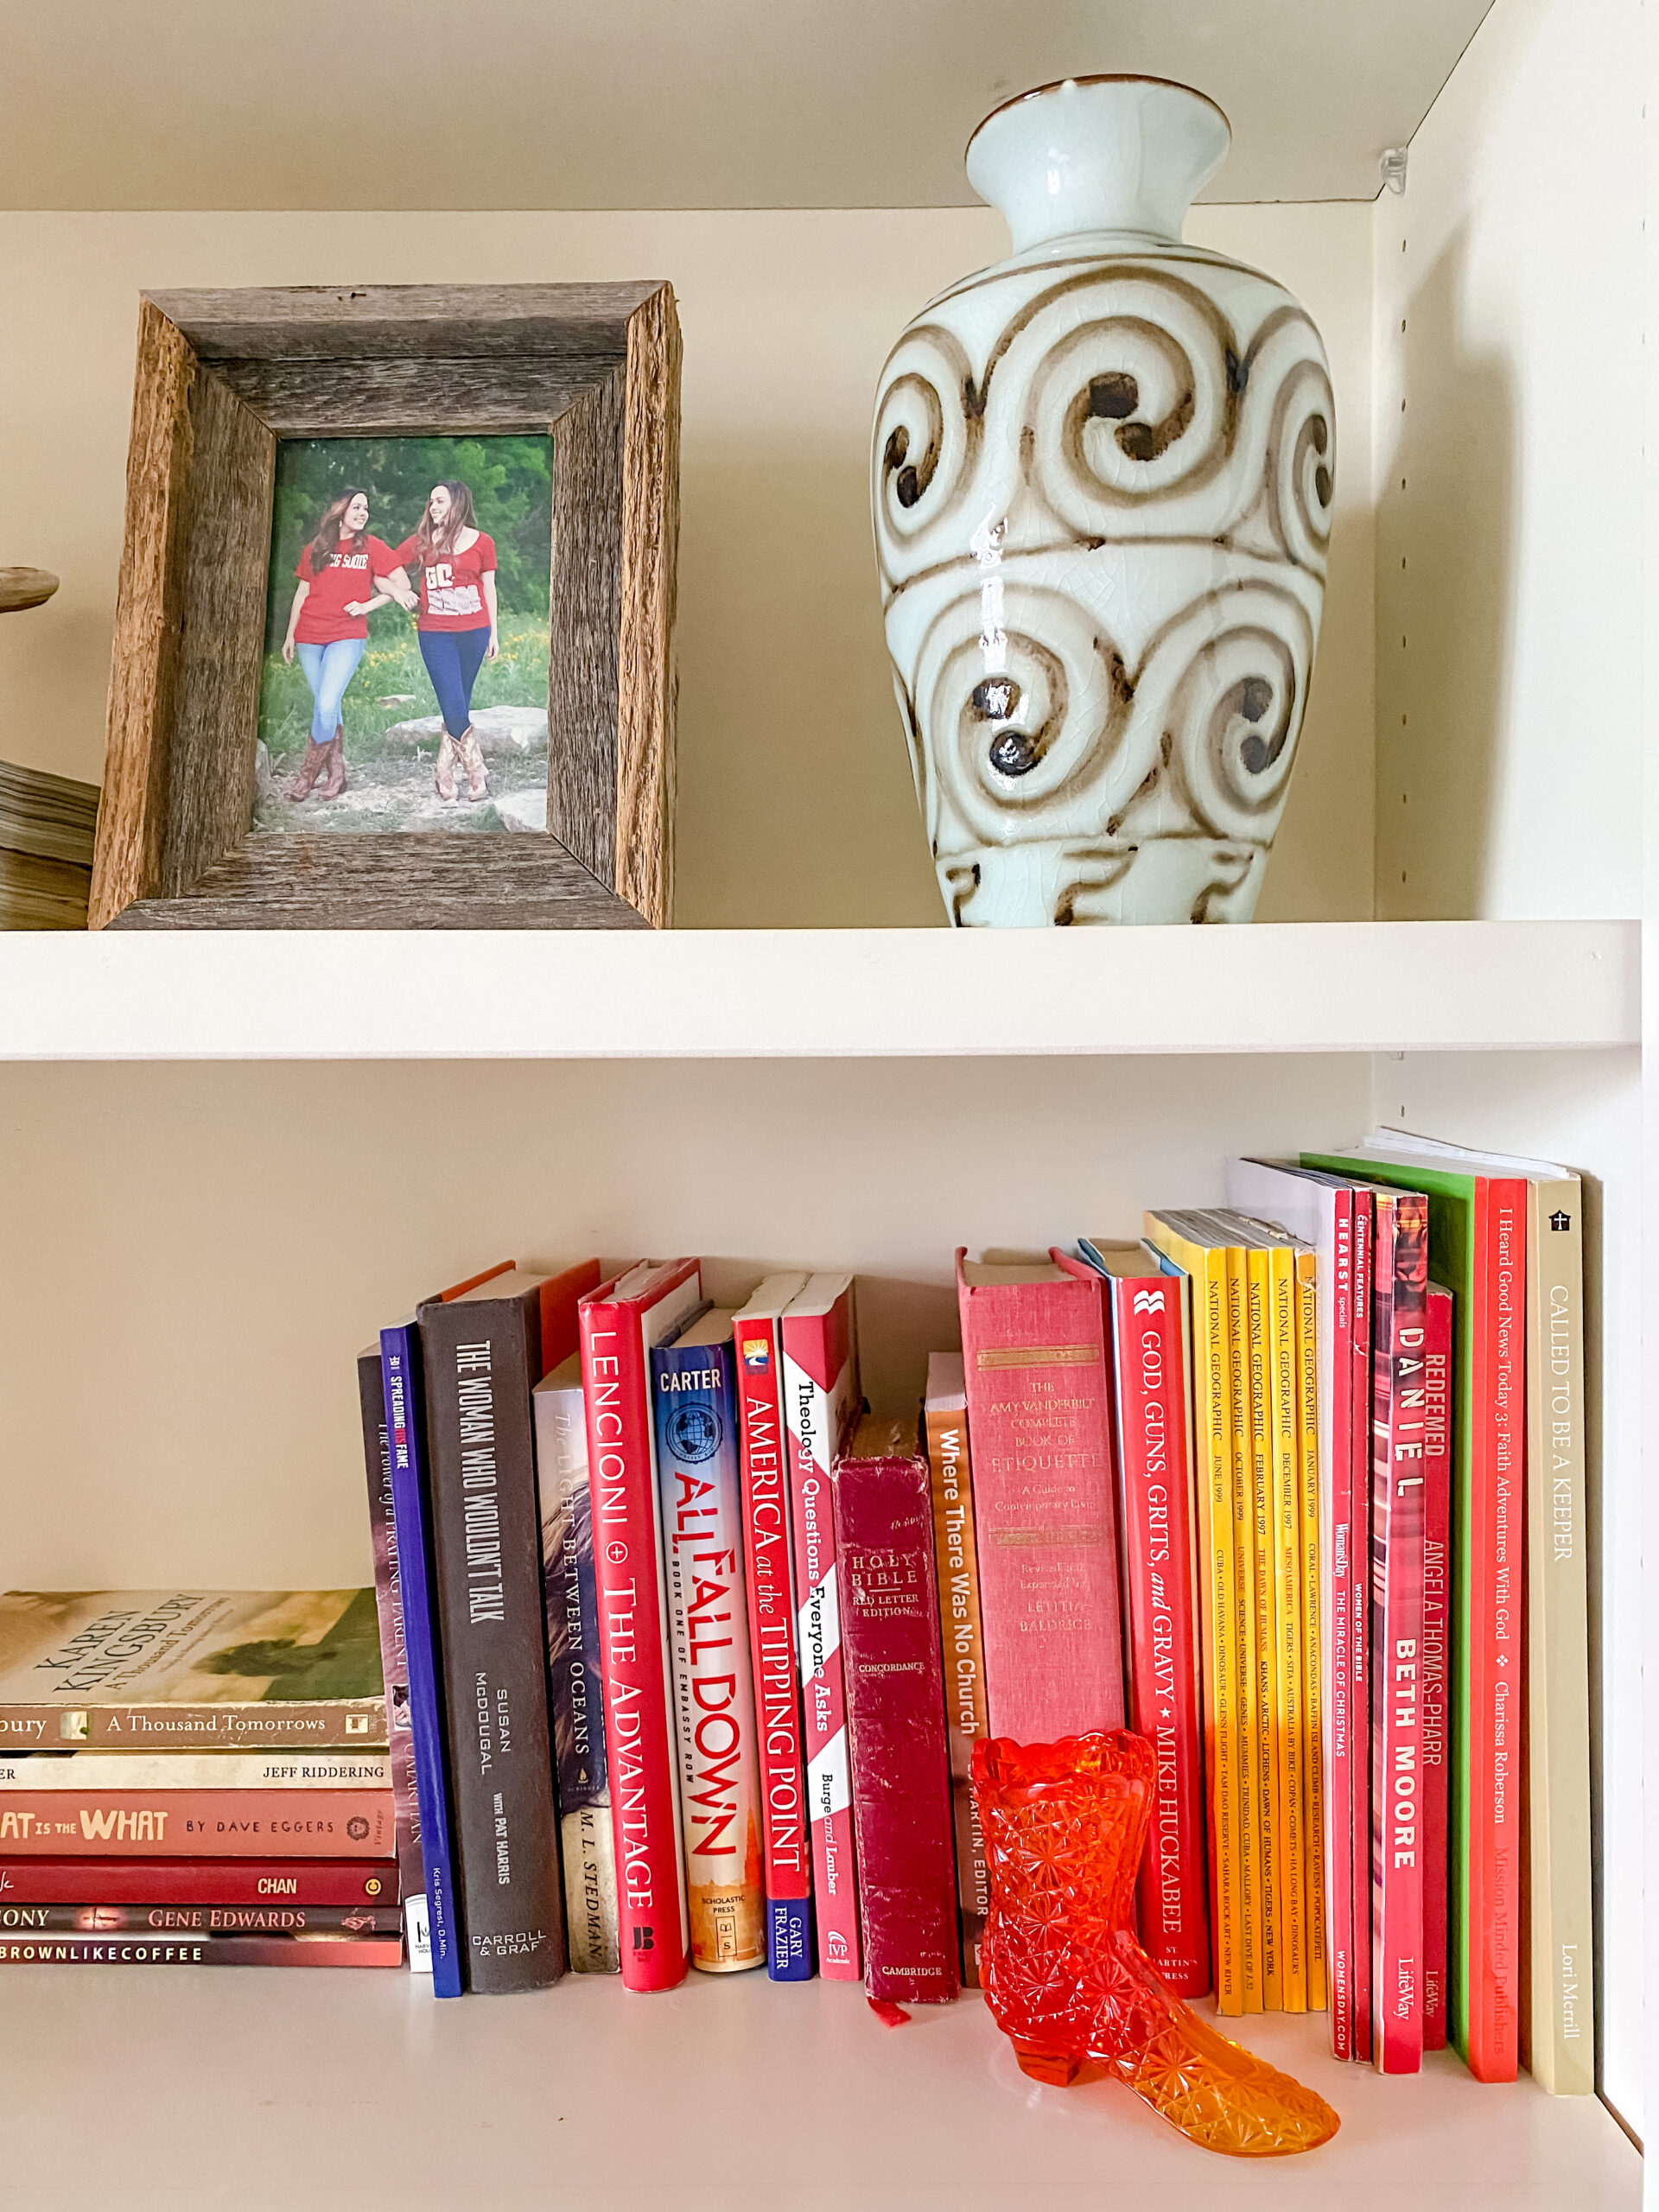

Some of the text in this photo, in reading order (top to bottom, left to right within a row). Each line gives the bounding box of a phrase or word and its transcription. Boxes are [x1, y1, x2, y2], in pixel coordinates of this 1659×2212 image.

[1337, 1218, 1349, 1328] HEARST specials
[1498, 1219, 1513, 1267] Heard
[1356, 1273, 1364, 1318] FEATURES
[1498, 1271, 1513, 1311] Good
[1497, 1316, 1512, 1357] News
[660, 1369, 721, 1393] CARTER
[1210, 1281, 1224, 1503] NATIONAL GEOGRAPHIC JUNE 1999
[1230, 1278, 1245, 1521] NATIONAL GEOGRAPHIC OCTOBER 1999
[1251, 1282, 1267, 1535] NATIONAL GEOGRAPHIC FEBRUARY 1997
[1278, 1278, 1292, 1529] NATIONAL GEOGRAPHIC DECEMBER 1997
[1301, 1276, 1317, 1517] NATIONAL GEOGRAPHIC JANUARY 1999
[1494, 1362, 1512, 1408] Today
[391, 1376, 409, 1468] SPREADING FAME
[590, 1332, 628, 1523] LENCIONI
[1014, 1435, 1052, 1448] BOOK
[1495, 1413, 1510, 1427] 3:
[1497, 1433, 1512, 1470] Faith
[1550, 1286, 1573, 1562] CALLED TO BE A KEEPER
[456, 1340, 505, 1624] THE WOMAN WHO WOULDN'T TALK
[671, 1471, 718, 1554] ALL
[1496, 1475, 1512, 1562] Adventures
[798, 1382, 832, 1732] Theology Questions Everyone Asks
[851, 1570, 918, 1586] BIBLE
[852, 1554, 912, 1570] HOLY
[940, 1428, 979, 1734] Where There Was No Church
[1422, 1354, 1446, 1766] REDEEMED ANGELA THOMAS-PHARR
[1496, 1567, 1511, 1604] With
[558, 1455, 588, 1755] LIGHT BETWEEN OCEANS
[688, 1548, 735, 1666] FALL
[852, 1593, 919, 1607] RED LETTER
[862, 1606, 910, 1618] EDITION
[1355, 1621, 1363, 1633] OF
[1394, 1327, 1425, 1870] DANIEL BETH MOORE
[1495, 1609, 1510, 1640] God
[34, 1611, 140, 1669] KAREN
[52, 1593, 205, 1692] KINGSBURY
[105, 1639, 180, 1690] A Thousand
[746, 1396, 802, 1872] AMERICA at the TIPPING POINT
[1140, 1331, 1182, 1934] GOD, GUNS, GRITS, and GRAVY MIKE HUCKABEE
[671, 1560, 694, 1784] BOOK ONE OF EMBASSY ROW
[858, 1662, 925, 1673] CONCORDANCE
[1336, 1591, 1346, 1758] THE MIRACLE OF CHRISTMAS
[106, 1714, 326, 1732] A Thousand Tomorrows
[475, 1672, 493, 1774] McDOUGAL
[497, 1688, 512, 1752] SUSAN
[603, 1577, 654, 1909] THE ADVANTAGE
[1494, 1681, 1510, 1746] Charissa
[263, 1766, 385, 1779] JEFF RIDDERING
[690, 1674, 741, 1856] DOWN
[1493, 1751, 1510, 1825] Roberson
[35, 1808, 334, 1841] IS THE WHAT BY DAVE EGGERS
[493, 1793, 511, 1885] WITH PAT HARRIS
[820, 1774, 841, 1896] Burge and Lauber
[257, 1878, 297, 1895] CHAN
[433, 1867, 442, 1886] Kris
[581, 1811, 603, 1959] M. L. STEDMAN
[974, 1859, 989, 1916] EDITOR
[1493, 1848, 1509, 1906] Mission
[149, 1909, 306, 1928] GENE EDWARDS
[473, 1929, 547, 1948] CARROLL
[480, 1941, 541, 1956] & GRAF
[774, 1906, 790, 1969] FRAZIER
[789, 1916, 803, 1957] GARY
[828, 1943, 849, 1957] IVP
[1493, 1912, 1509, 1969] Minded
[882, 1966, 943, 1977] CAMBRIDGE
[1337, 1949, 1346, 2050] WOMENSDAY.COM
[1393, 1956, 1414, 2021] LifeWay
[1561, 1945, 1581, 2039] Lori Merrill
[1492, 1975, 1509, 2055] Publishers
